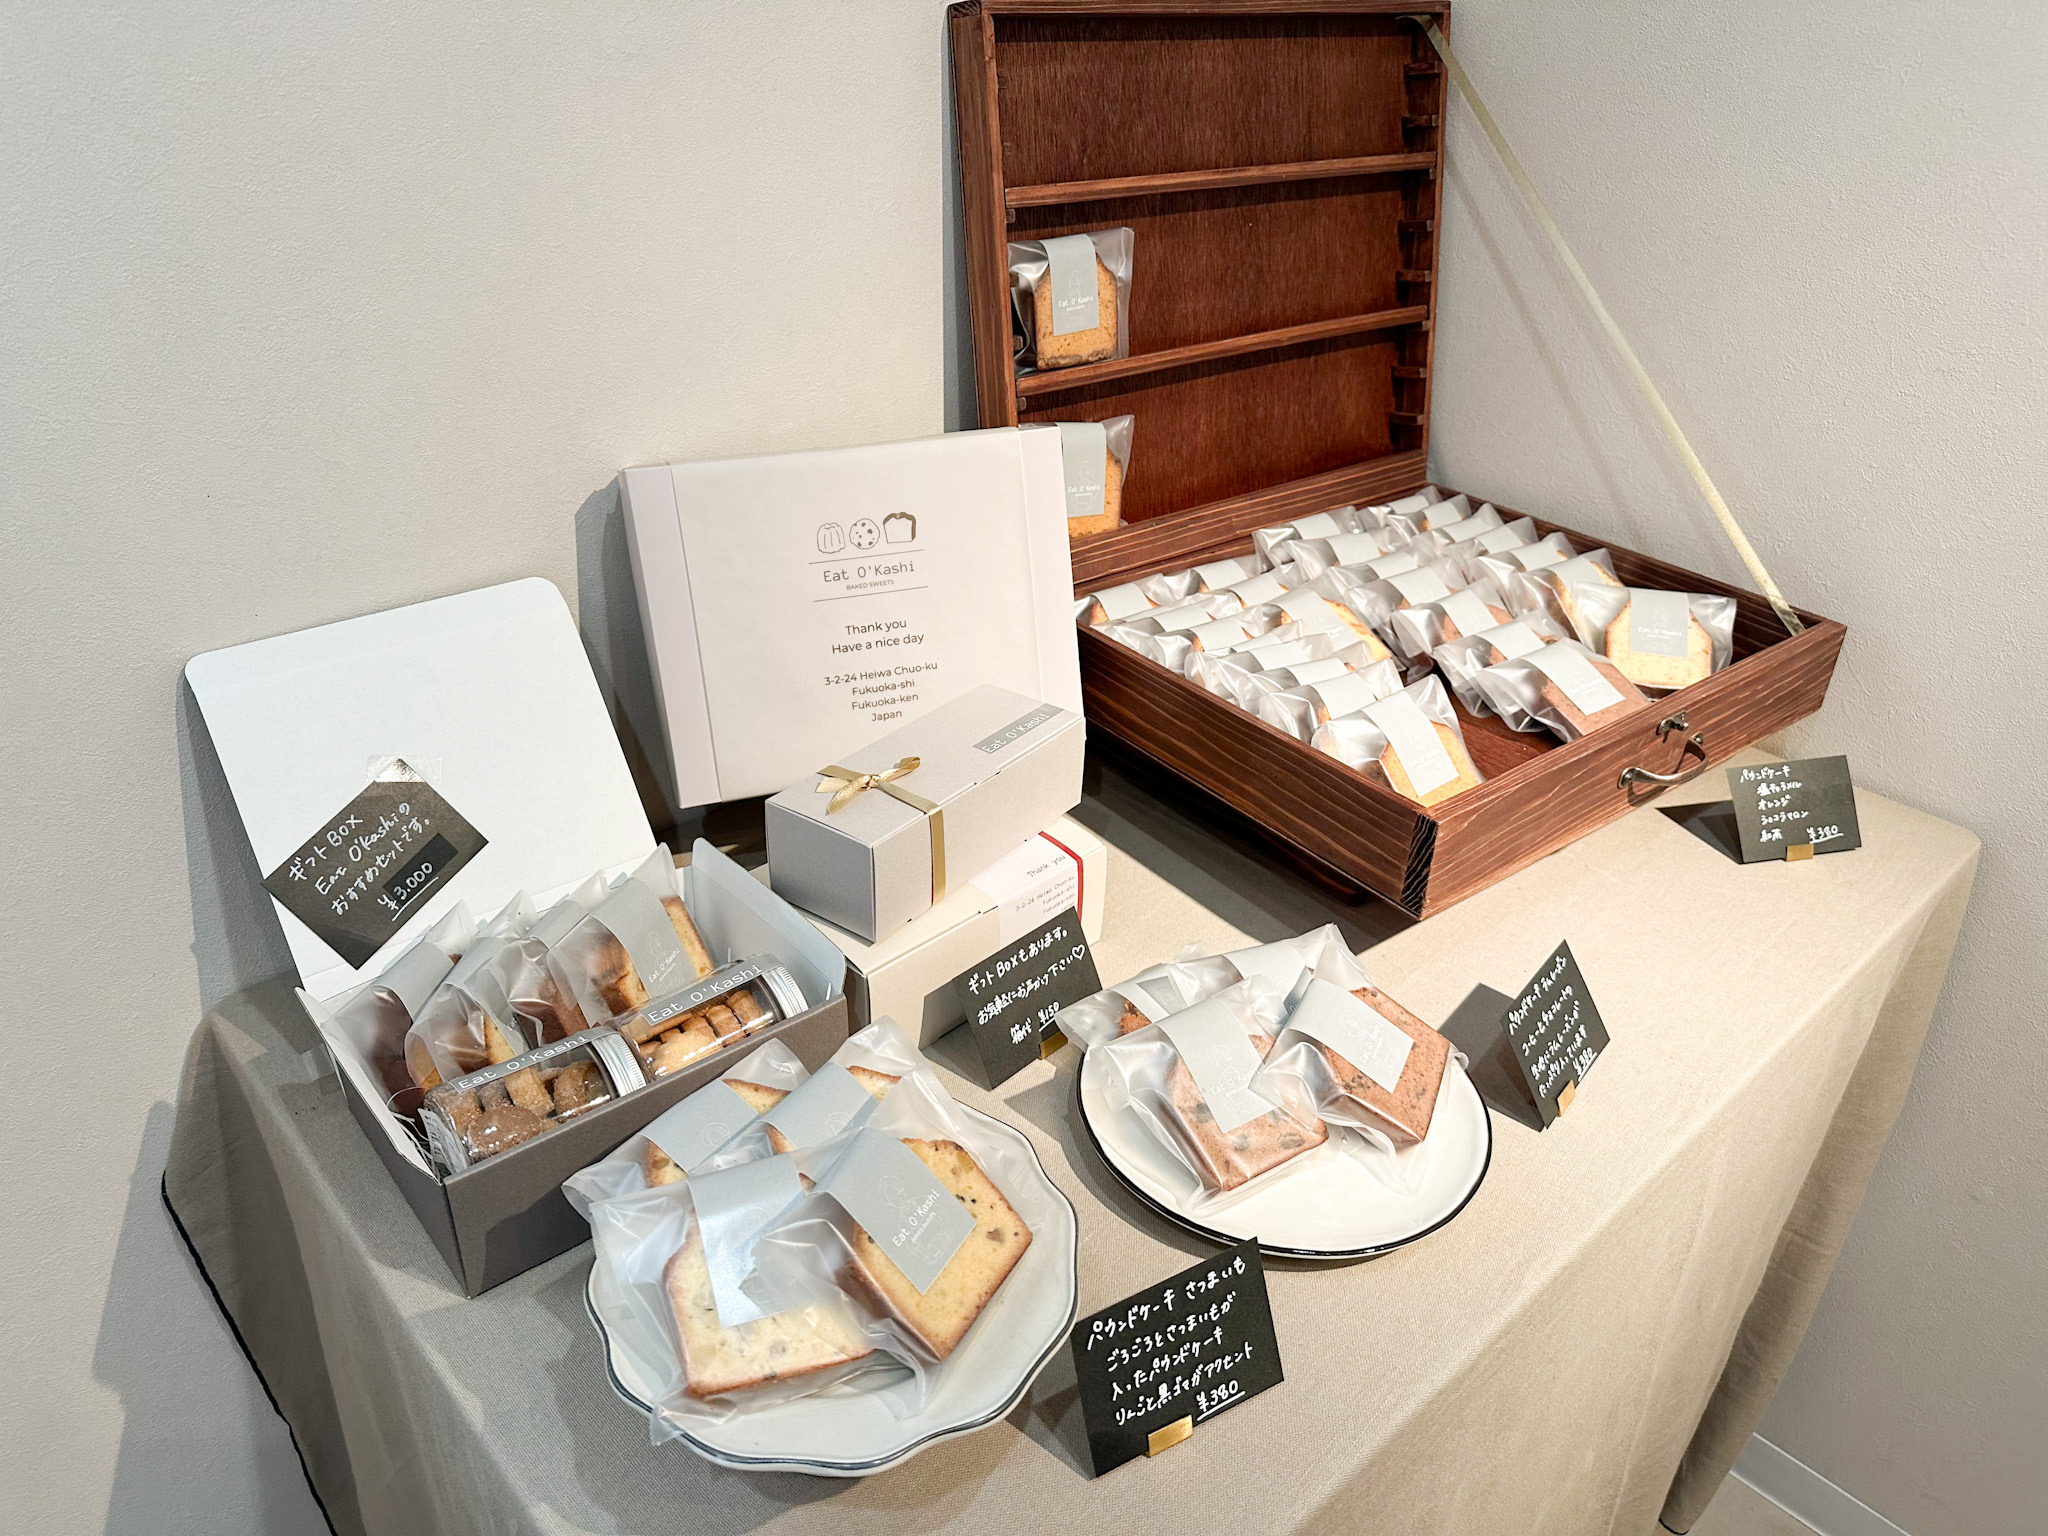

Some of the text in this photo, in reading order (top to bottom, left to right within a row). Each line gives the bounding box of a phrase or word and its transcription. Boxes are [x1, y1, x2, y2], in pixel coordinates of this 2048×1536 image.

[823, 560, 915, 583] Eat O'Kashi
[846, 579, 895, 591] BAKED SWEETS
[845, 620, 907, 636] Thank you
[832, 634, 924, 654] Have a nice day
[824, 661, 938, 686] 3-2-24 Heiwa Chuo-ku
[852, 679, 915, 696] Fukuoka-shi
[851, 693, 919, 710] Fukuoka-ken
[871, 709, 902, 722] Japan
[982, 712, 1051, 754] Eat O'Kashi
[1740, 764, 1791, 783] パウンドケーキ
[1757, 793, 1792, 811] オレンジ
[1760, 810, 1809, 825] ショコラマロン
[1806, 824, 1839, 842] ¥380
[1026, 855, 1066, 877] Thank you
[314, 866, 347, 895] Eat
[649, 970, 660, 983] Eat
[648, 1003, 684, 1022] Eat
[690, 964, 763, 1002] O'Kashi
[1037, 1001, 1060, 1025] ¥150
[458, 1035, 588, 1089] Eat O'Kashi
[1572, 1046, 1595, 1077] ¥380
[1210, 1084, 1226, 1095] Eat
[892, 1228, 910, 1248] Eat
[909, 1188, 941, 1226] O'Kashi
[1087, 1256, 1246, 1350] パウンドケーキ さつまいも
[1112, 1325, 1224, 1401] 入ったパウンドケーキ
[1196, 1379, 1240, 1412] ¥380
